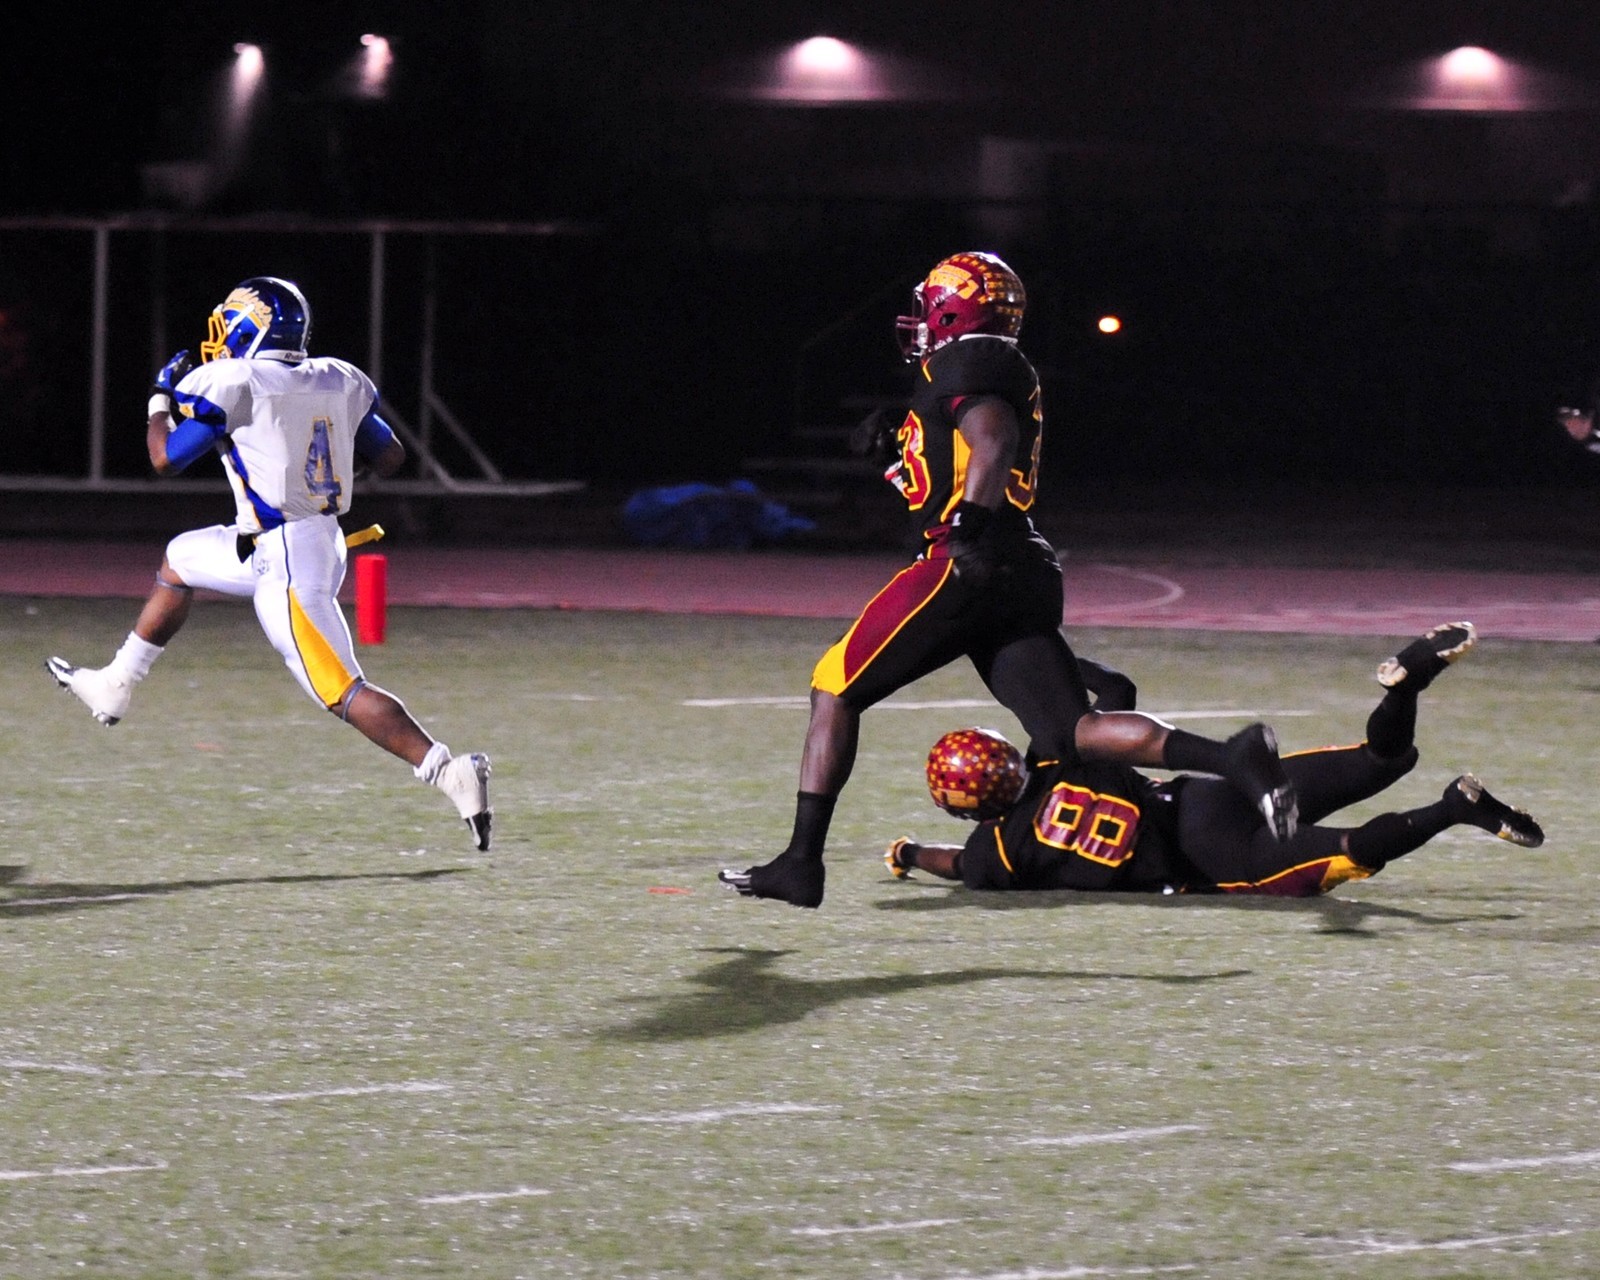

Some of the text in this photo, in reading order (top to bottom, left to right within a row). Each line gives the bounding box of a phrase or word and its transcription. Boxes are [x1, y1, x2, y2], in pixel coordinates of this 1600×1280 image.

[305, 416, 342, 515] 4
[898, 410, 931, 511] 3
[1033, 781, 1140, 867] 8
